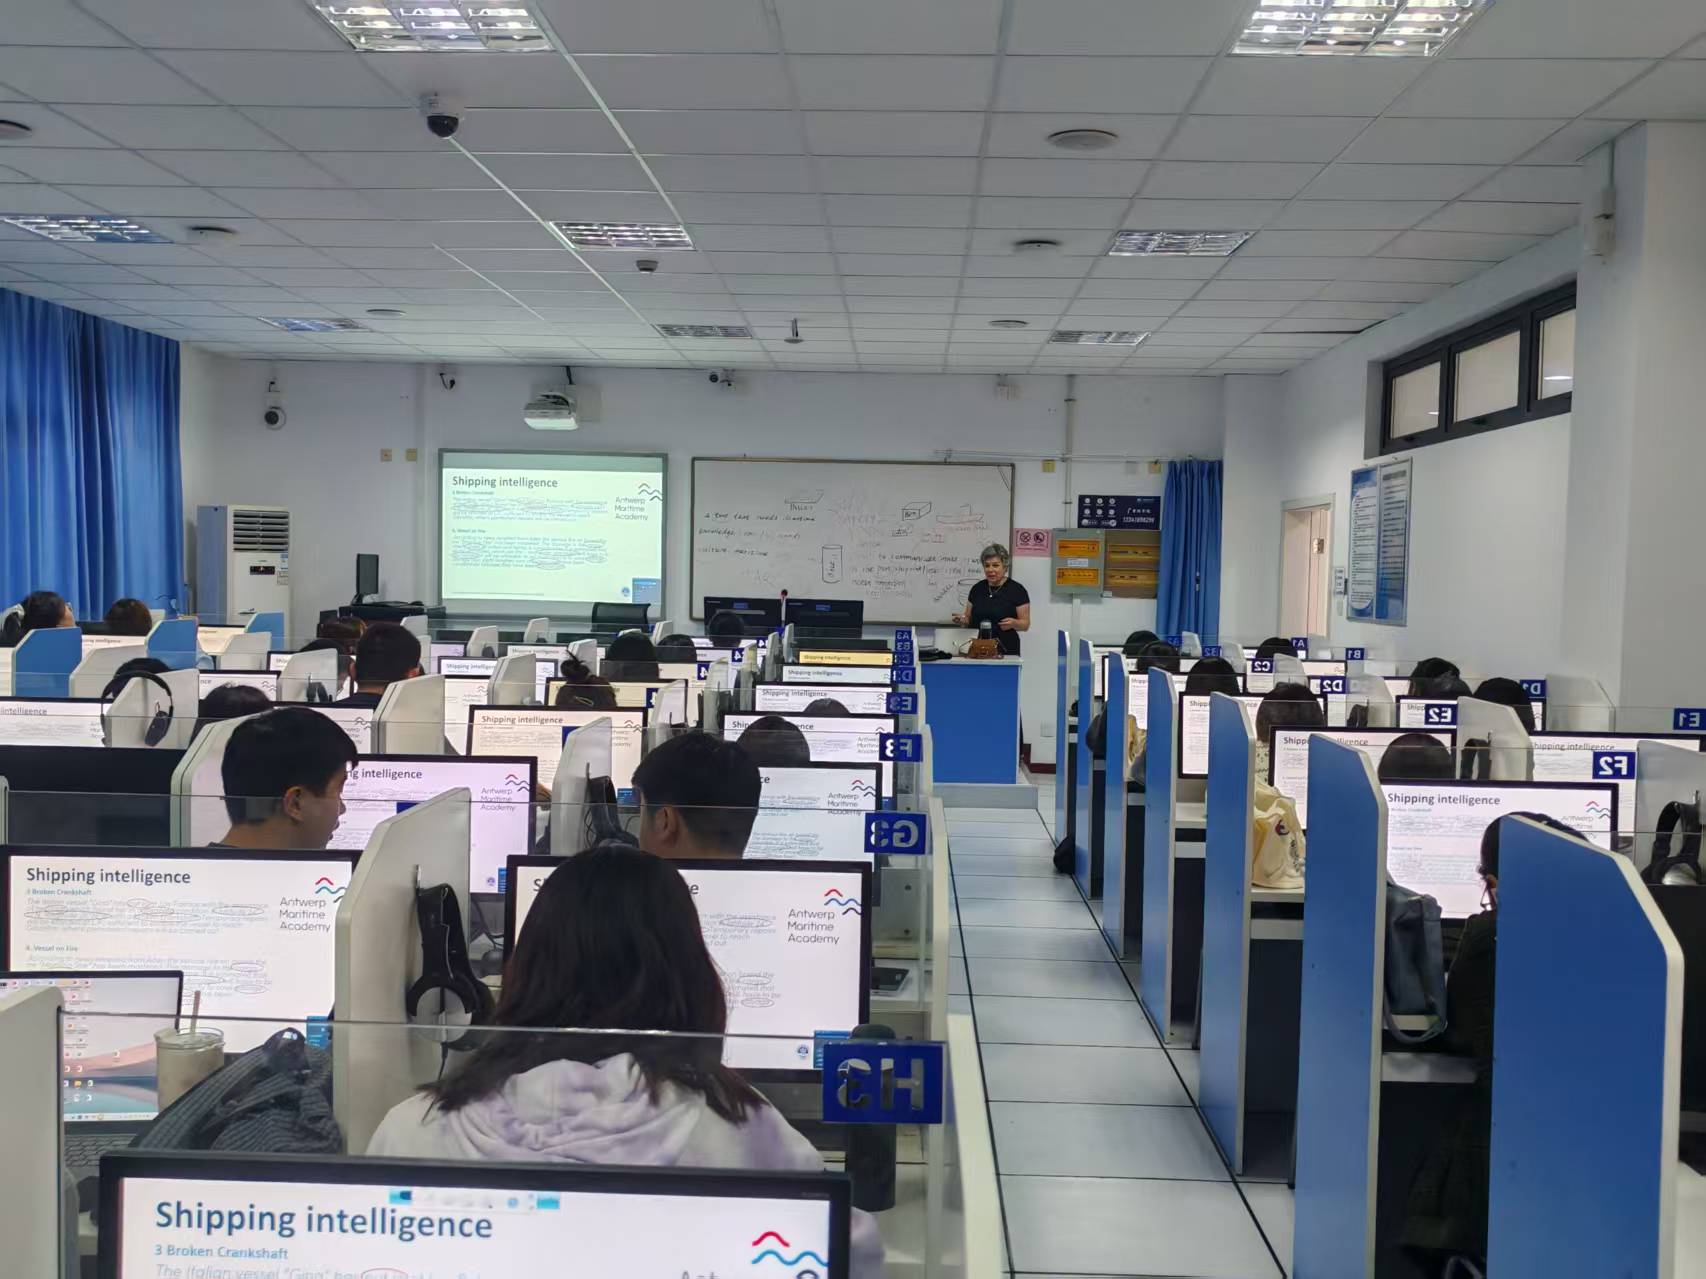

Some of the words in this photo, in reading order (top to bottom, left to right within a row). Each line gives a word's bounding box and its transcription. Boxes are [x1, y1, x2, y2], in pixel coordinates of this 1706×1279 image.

[452, 475, 497, 488] Shipping
[499, 477, 558, 489] intelligence
[446, 663, 469, 671] Shipping
[471, 664, 495, 672] intelligen
[761, 689, 789, 698] Shipping
[791, 690, 828, 698] intelligence
[1189, 700, 1210, 708] Shipp
[1406, 704, 1425, 712] Shipp
[481, 715, 516, 725] Shipping
[517, 717, 564, 726] intelligence
[1283, 735, 1308, 746] Shipp
[1566, 743, 1616, 753] intelligence
[361, 767, 423, 780] intelligence
[480, 787, 513, 796] Antwerp
[827, 792, 860, 801] Antwerp
[1387, 792, 1435, 806] Shipping
[1437, 794, 1501, 807] intelligence
[480, 803, 515, 812] Academy
[26, 867, 96, 885] Shipping
[99, 868, 192, 886] intelligence
[279, 896, 327, 909] Antwerp
[279, 909, 326, 919] Maritime
[787, 908, 836, 921] Antwerp
[279, 920, 331, 933] Academy
[786, 920, 834, 931] Maritime
[786, 933, 840, 945] Academy
[156, 1201, 297, 1237] Shipping
[306, 1205, 493, 1241] intelligence
[154, 1244, 163, 1256] 3
[167, 1245, 214, 1258] Broken
[217, 1246, 289, 1260] Crankshaft
[156, 1264, 183, 1278] The
